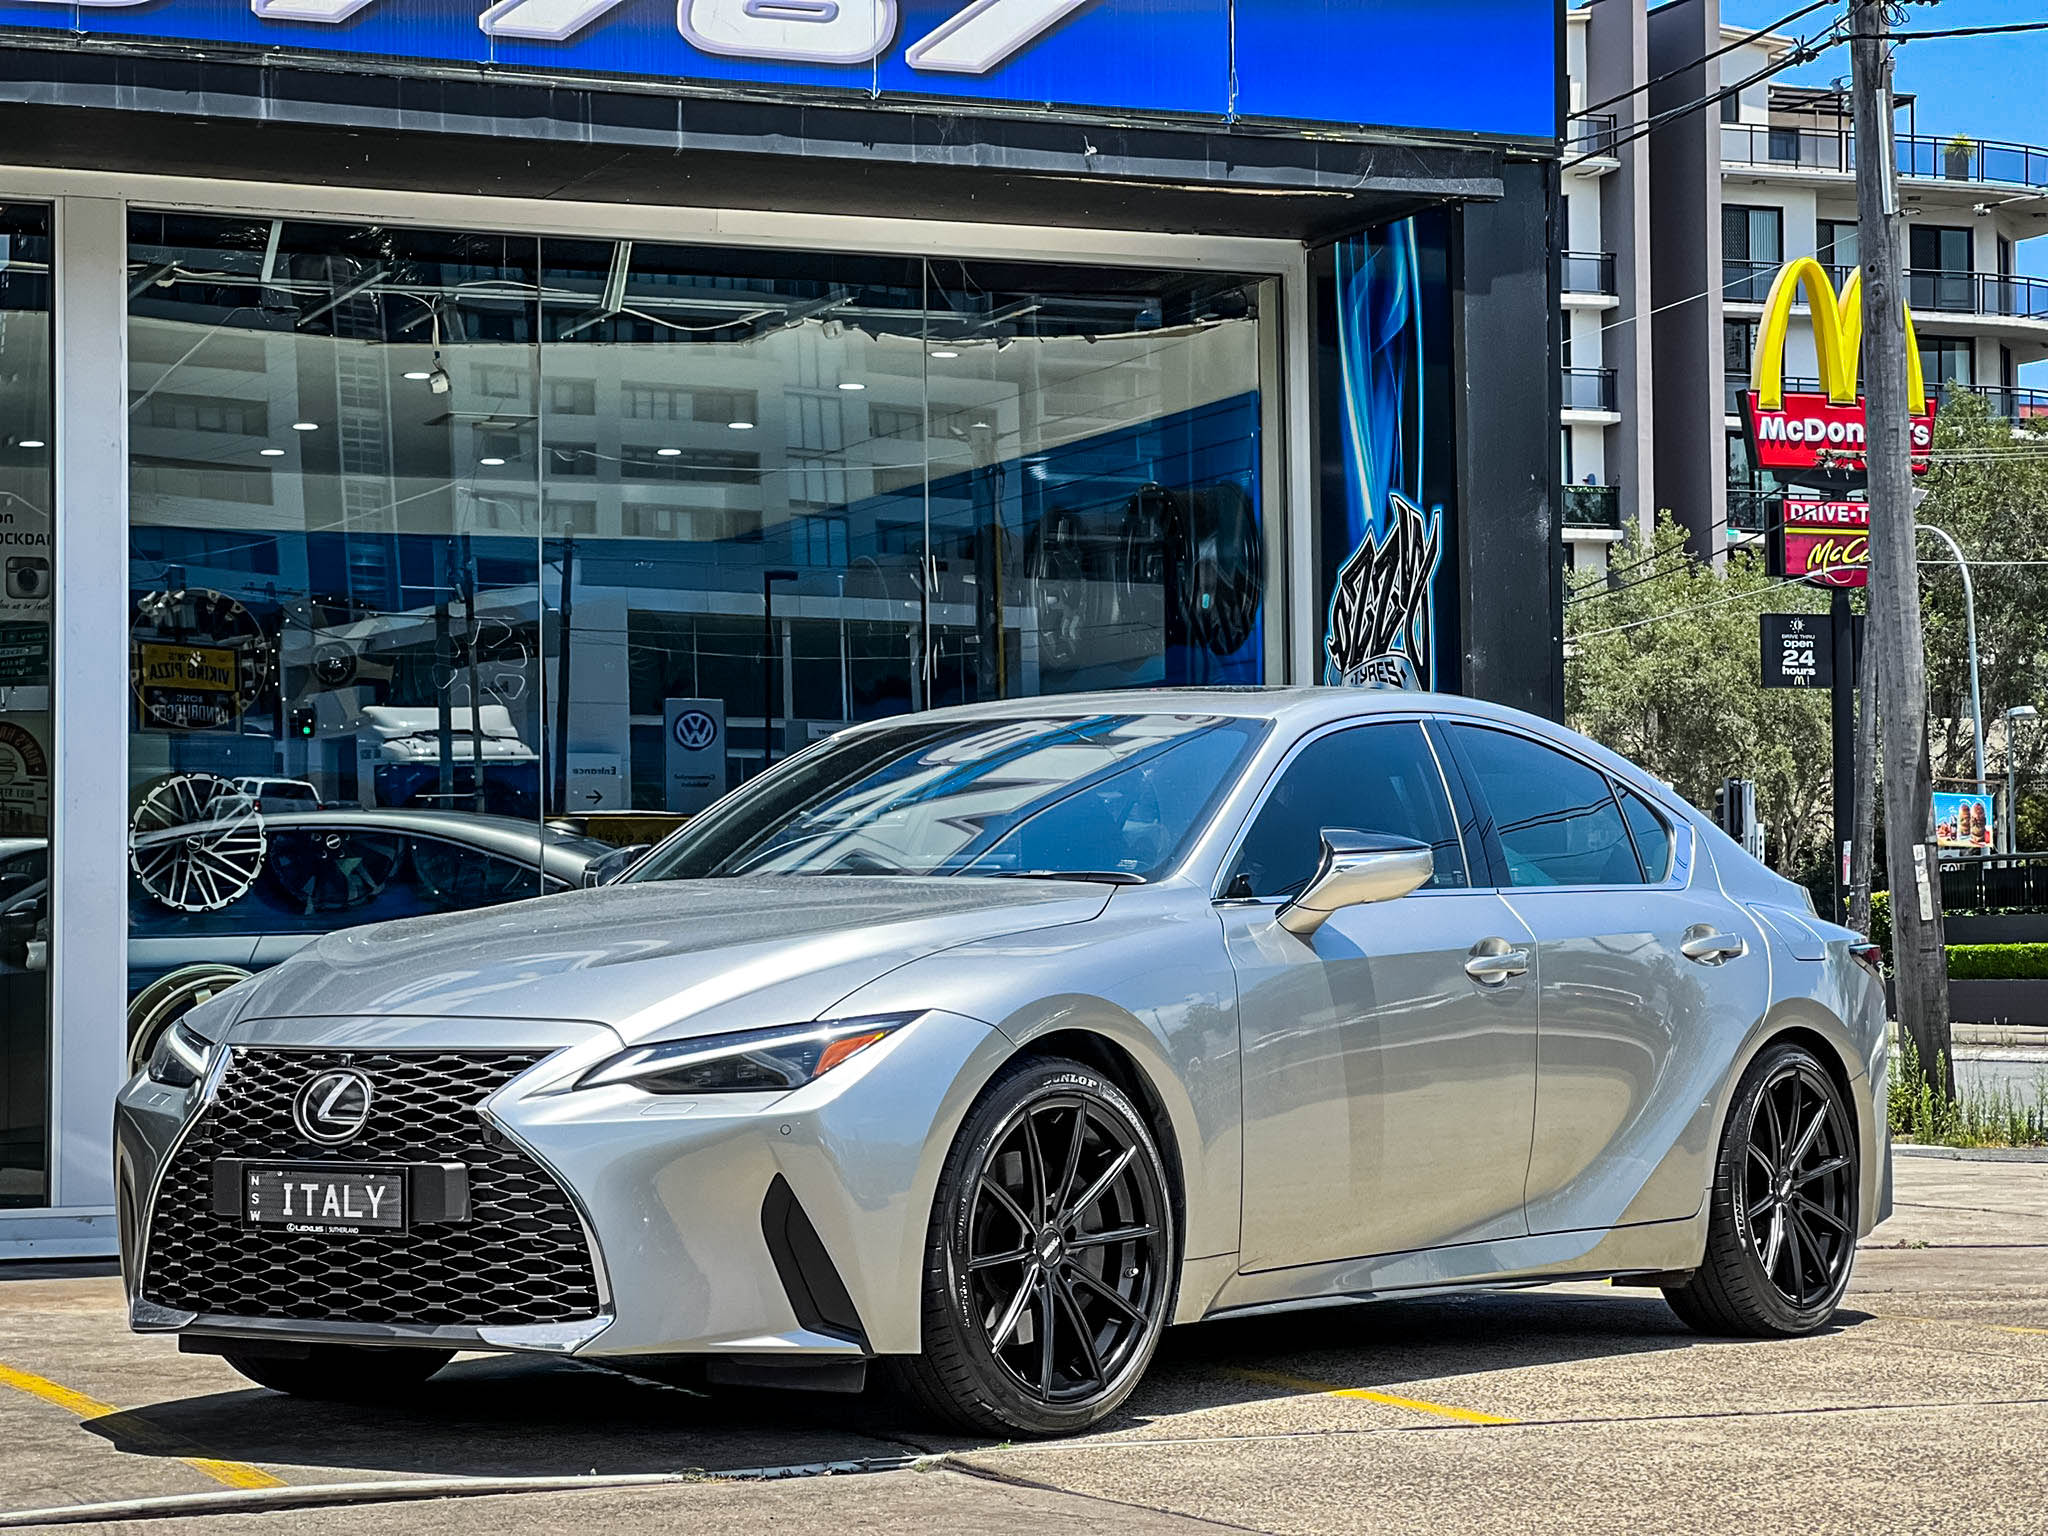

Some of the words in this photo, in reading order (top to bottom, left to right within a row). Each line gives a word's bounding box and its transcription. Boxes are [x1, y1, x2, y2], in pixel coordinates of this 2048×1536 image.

[1783, 640, 1814, 650] open
[1782, 649, 1816, 667] 24
[1353, 660, 1401, 688] TYRES
[1781, 665, 1816, 676] hours
[282, 1182, 386, 1219] ITALY
[295, 1224, 324, 1233] LEXUS
